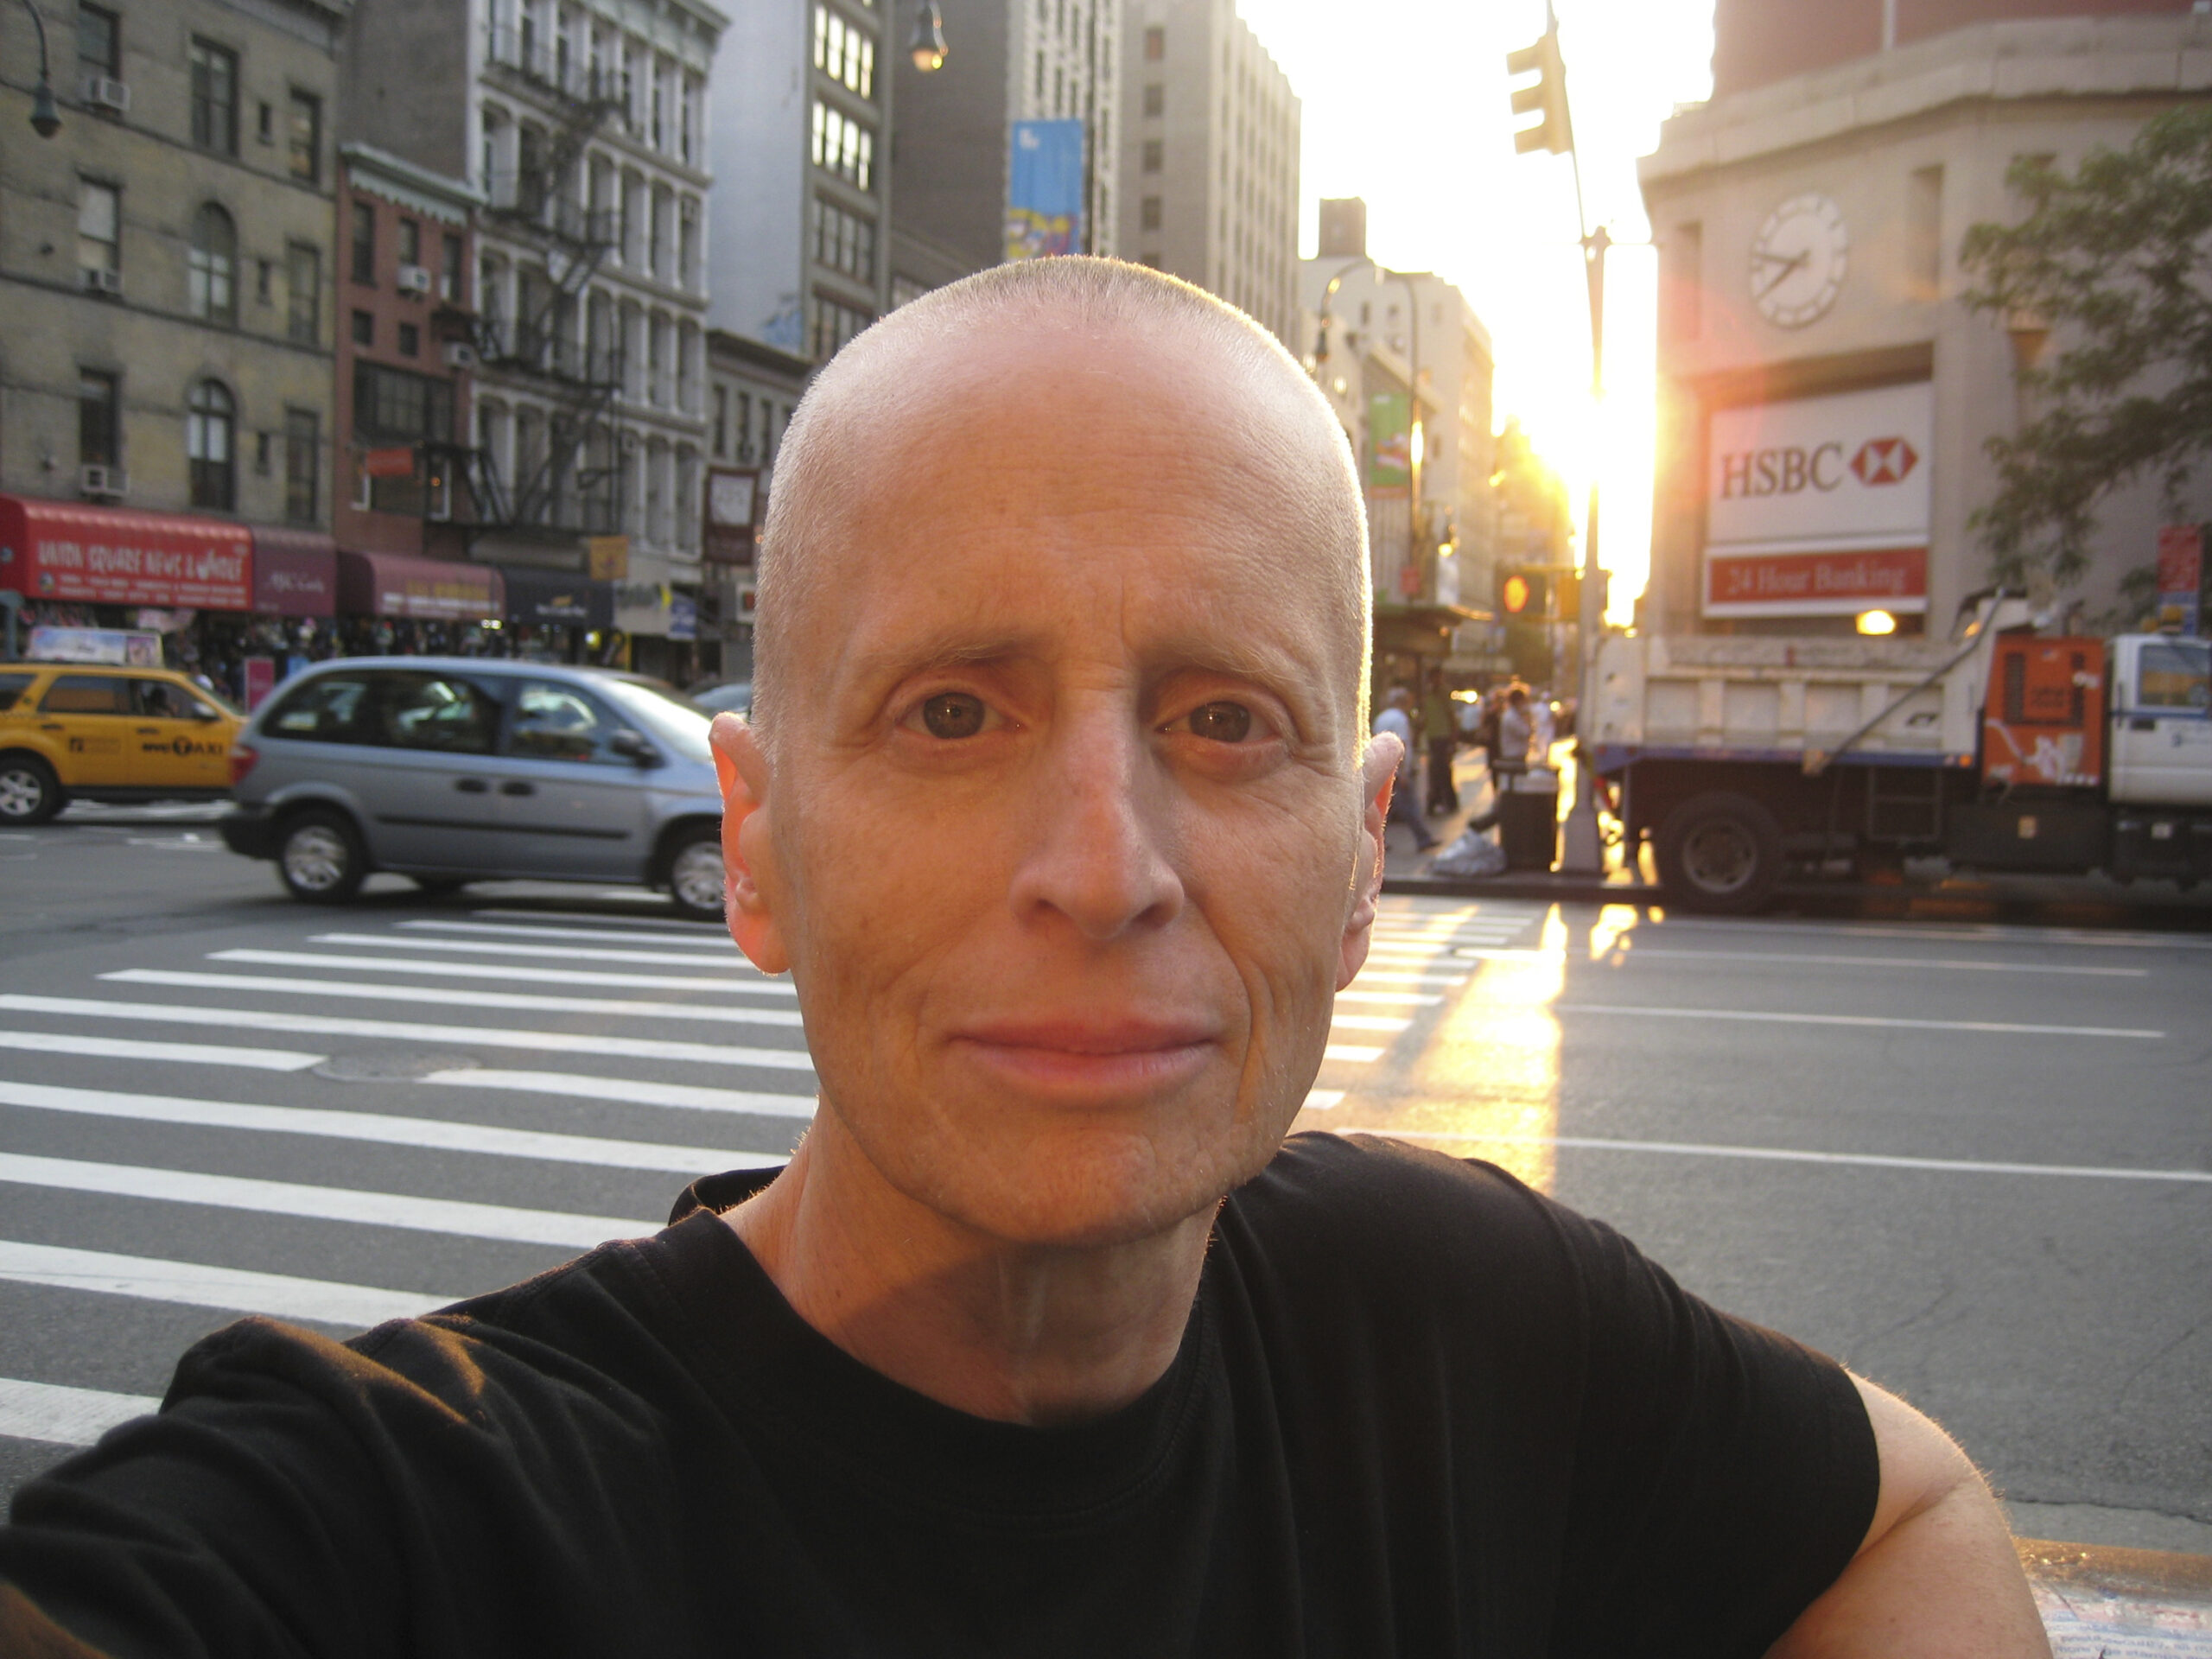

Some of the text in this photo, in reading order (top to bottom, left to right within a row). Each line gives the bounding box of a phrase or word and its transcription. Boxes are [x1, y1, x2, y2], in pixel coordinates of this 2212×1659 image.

[1719, 442, 1844, 499] HSBC
[87, 543, 143, 575] SQUARE
[1728, 559, 1906, 596] 24 Hour Banking
